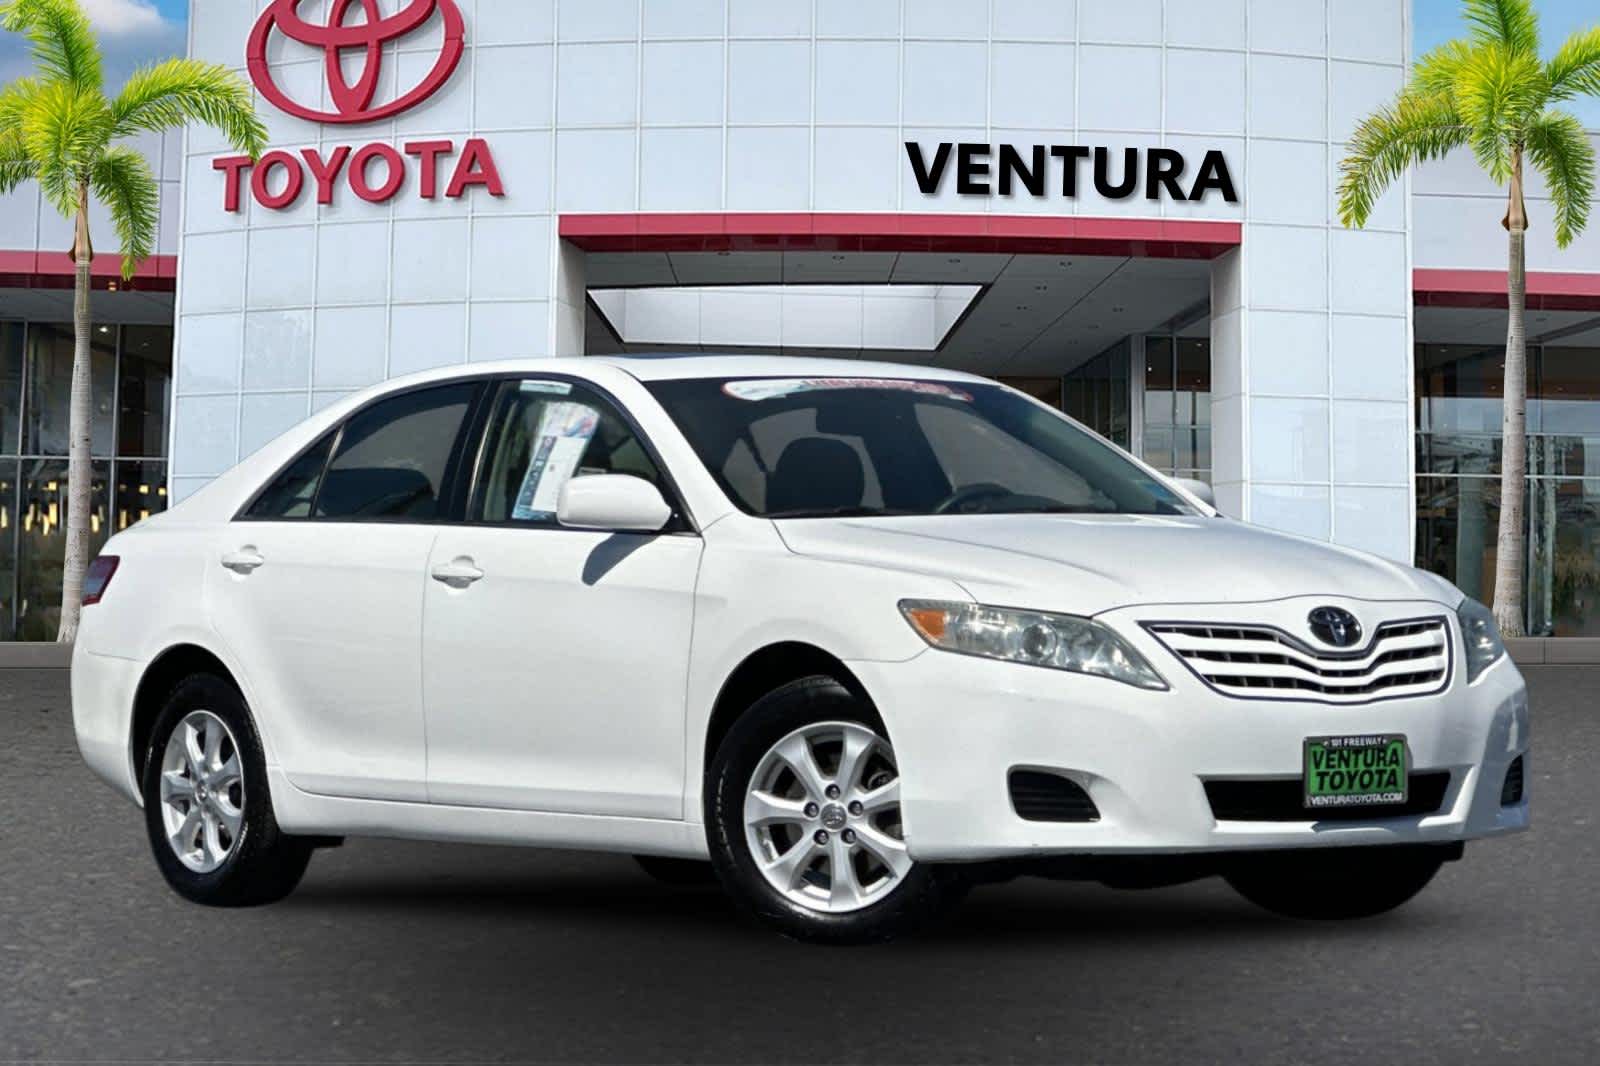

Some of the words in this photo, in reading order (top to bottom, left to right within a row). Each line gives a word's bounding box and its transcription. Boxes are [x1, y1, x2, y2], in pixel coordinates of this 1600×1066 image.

[212, 138, 505, 212] TOYOTA
[904, 142, 1239, 202] VENTURA
[1343, 736, 1382, 746] FREEWAY
[1312, 747, 1400, 769] VENTURA
[1316, 769, 1399, 791] TOYOTA
[1310, 792, 1402, 805] VENTURATOYOTA.COM
